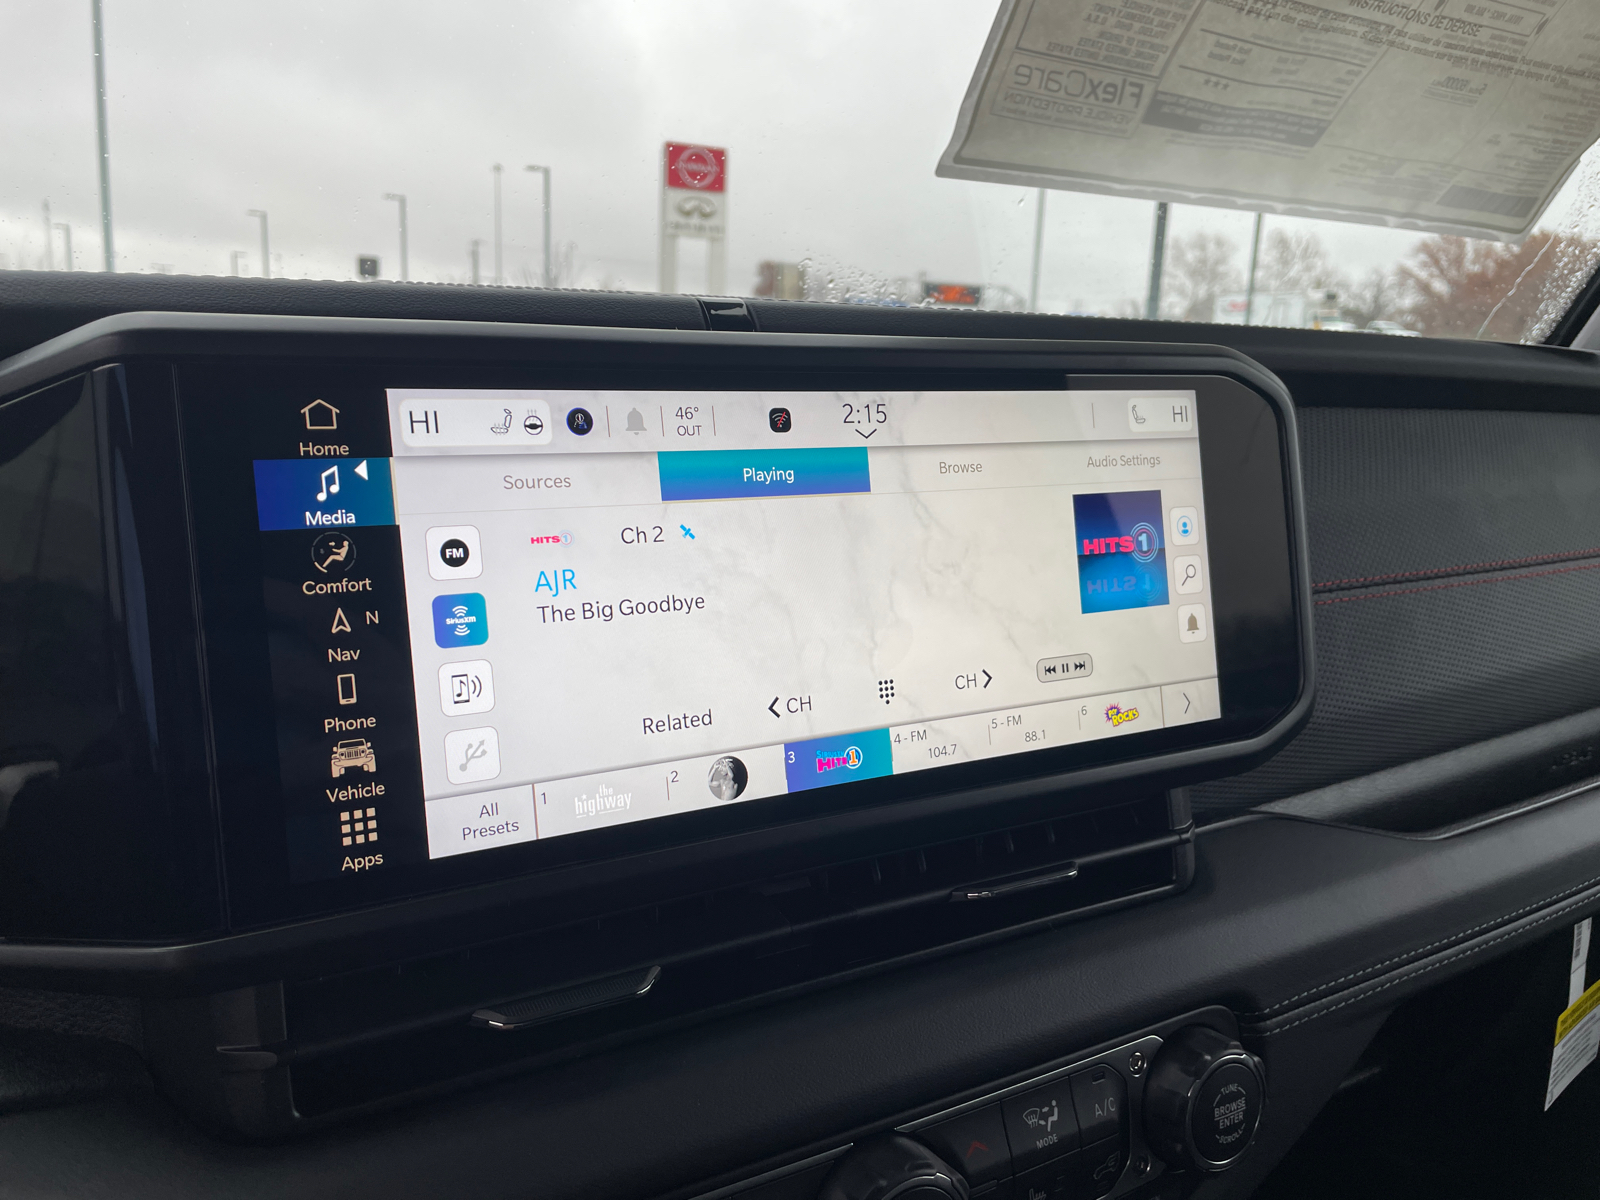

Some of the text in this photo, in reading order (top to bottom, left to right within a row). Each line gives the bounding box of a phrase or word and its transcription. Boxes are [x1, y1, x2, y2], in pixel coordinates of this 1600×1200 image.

[408, 410, 440, 434] HI
[842, 403, 888, 425] 2:15
[1172, 405, 1189, 424] HI
[676, 424, 702, 437] OUT
[299, 442, 350, 457] Home
[939, 460, 983, 475] Browse
[1087, 453, 1161, 469] Audio Settings
[503, 474, 572, 491] Sources
[743, 467, 795, 484] Playing
[305, 509, 356, 527] Media
[620, 526, 665, 544] Ch 2
[445, 547, 464, 559] FM
[1083, 535, 1134, 555] HITS
[302, 577, 373, 596] Comfort
[534, 568, 578, 598] AJR
[365, 610, 380, 625] N
[537, 595, 706, 624] The Big Goodbye
[328, 648, 361, 662] Nav
[954, 673, 978, 690] CH
[786, 695, 813, 714] CH
[1081, 705, 1088, 716] 6
[324, 715, 377, 734] Phone
[642, 708, 713, 735] Related
[991, 717, 998, 730] 5
[1006, 714, 1022, 727] FM
[893, 733, 902, 744] 4
[910, 729, 928, 743] FM
[1024, 729, 1047, 743] 88.1
[787, 751, 796, 764] 3
[928, 744, 958, 759] 104.7
[670, 770, 680, 783] 2
[325, 781, 386, 804] Vehicle
[599, 783, 613, 796] the
[540, 792, 548, 805] 1
[574, 791, 632, 817] highway
[479, 802, 500, 818] All
[462, 820, 520, 841] Presets
[341, 852, 384, 873] Apps
[1221, 1083, 1240, 1095] TUNE
[1094, 1097, 1117, 1118] A/C
[1213, 1097, 1247, 1118] BROWSE
[1219, 1111, 1245, 1129] ENTER
[1035, 1134, 1059, 1149] MODE
[1218, 1127, 1245, 1144] SCROLL
